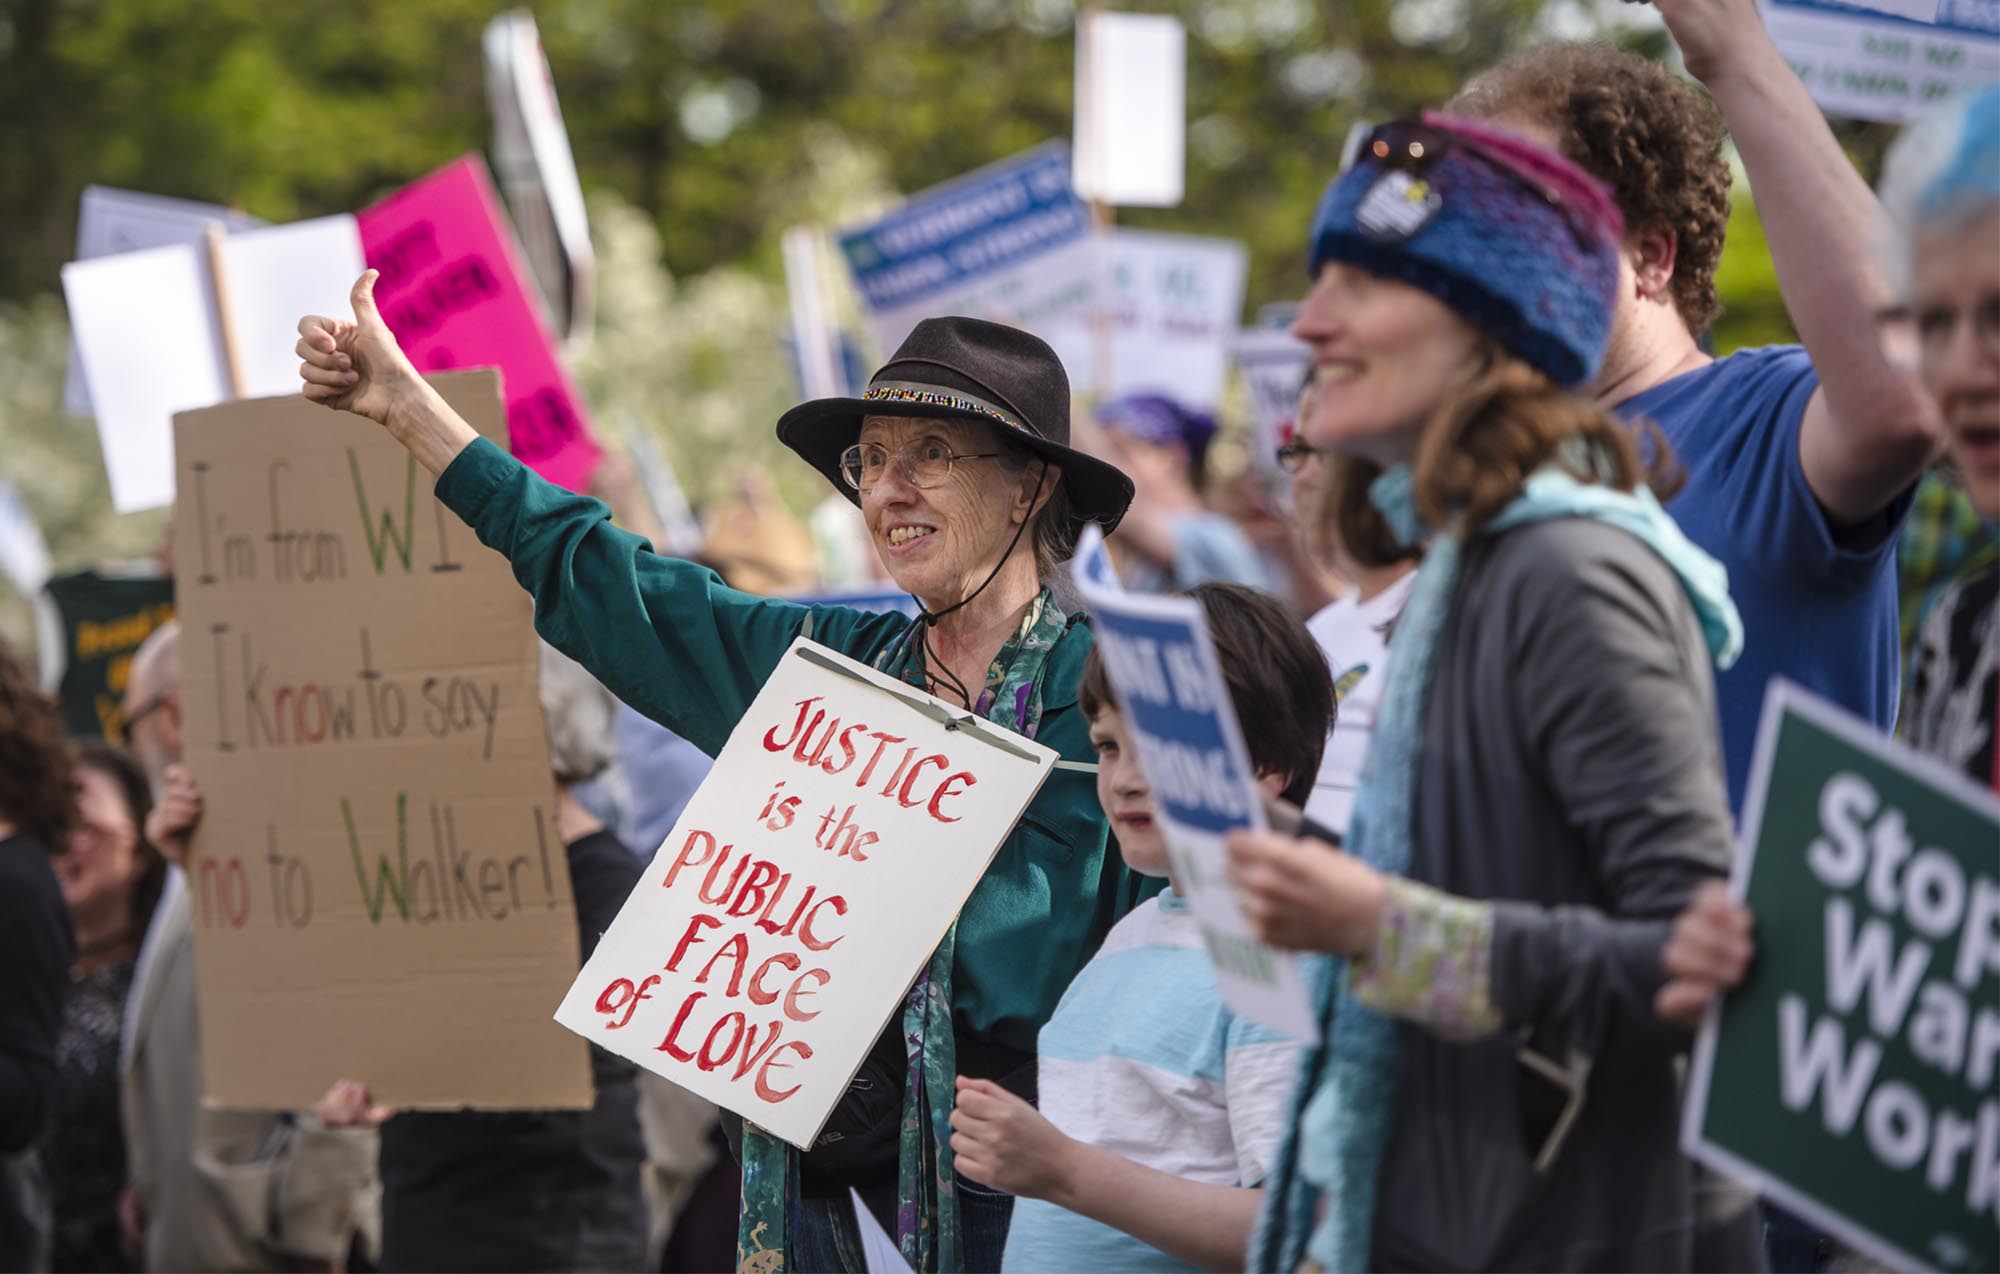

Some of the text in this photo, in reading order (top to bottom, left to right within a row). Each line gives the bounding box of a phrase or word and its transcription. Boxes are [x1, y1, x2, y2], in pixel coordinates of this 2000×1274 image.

[192, 461, 258, 585] I'm
[267, 458, 348, 583] from
[209, 623, 499, 761] I know to say
[757, 781, 880, 862] is the
[763, 695, 977, 823] JUSTICE
[200, 791, 559, 930] no to Walker!
[662, 829, 849, 951] PUBLIC
[664, 914, 831, 1023] FACE
[595, 974, 814, 1103] of LOVE
